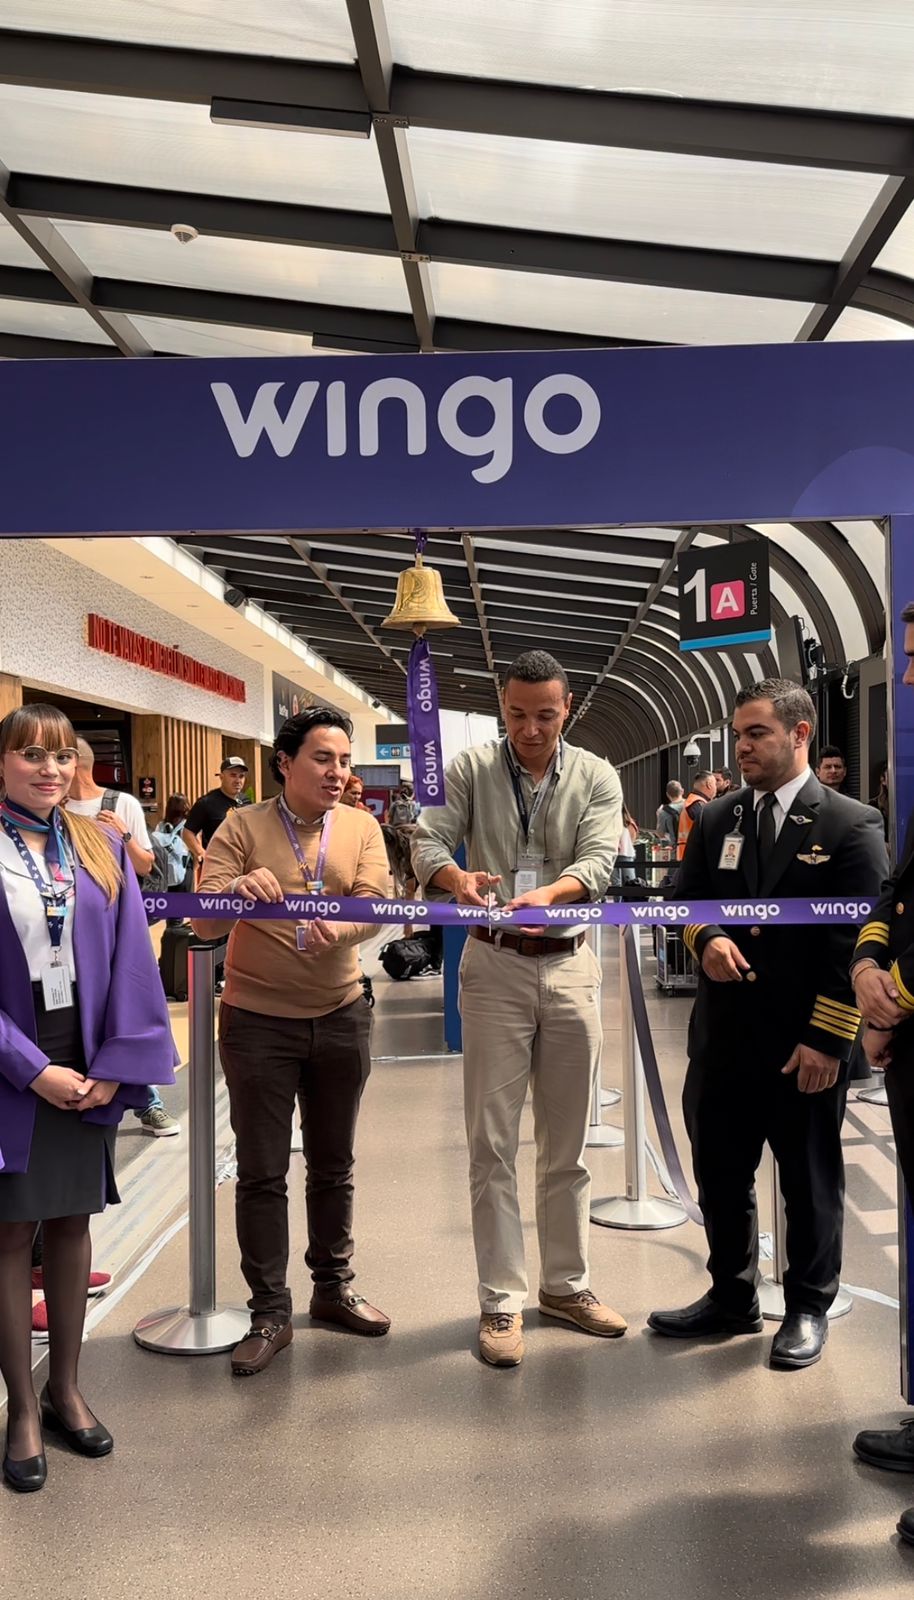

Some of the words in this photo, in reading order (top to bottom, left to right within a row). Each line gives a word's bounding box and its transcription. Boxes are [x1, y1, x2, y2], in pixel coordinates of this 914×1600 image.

[210, 373, 602, 484] wingo
[749, 562, 757, 580] Gate
[683, 568, 707, 622] 1
[715, 586, 739, 614] A
[750, 588, 758, 615] Puerta
[119, 626, 143, 666] VAYAS
[417, 657, 433, 712] wingo
[423, 740, 439, 796] wingo
[200, 898, 255, 914] wingo
[285, 899, 341, 916] wingo
[371, 903, 428, 920] wingo
[545, 907, 602, 921] wingo
[631, 905, 690, 921] wingo
[720, 903, 780, 920] wingo
[811, 902, 872, 918] wingo
